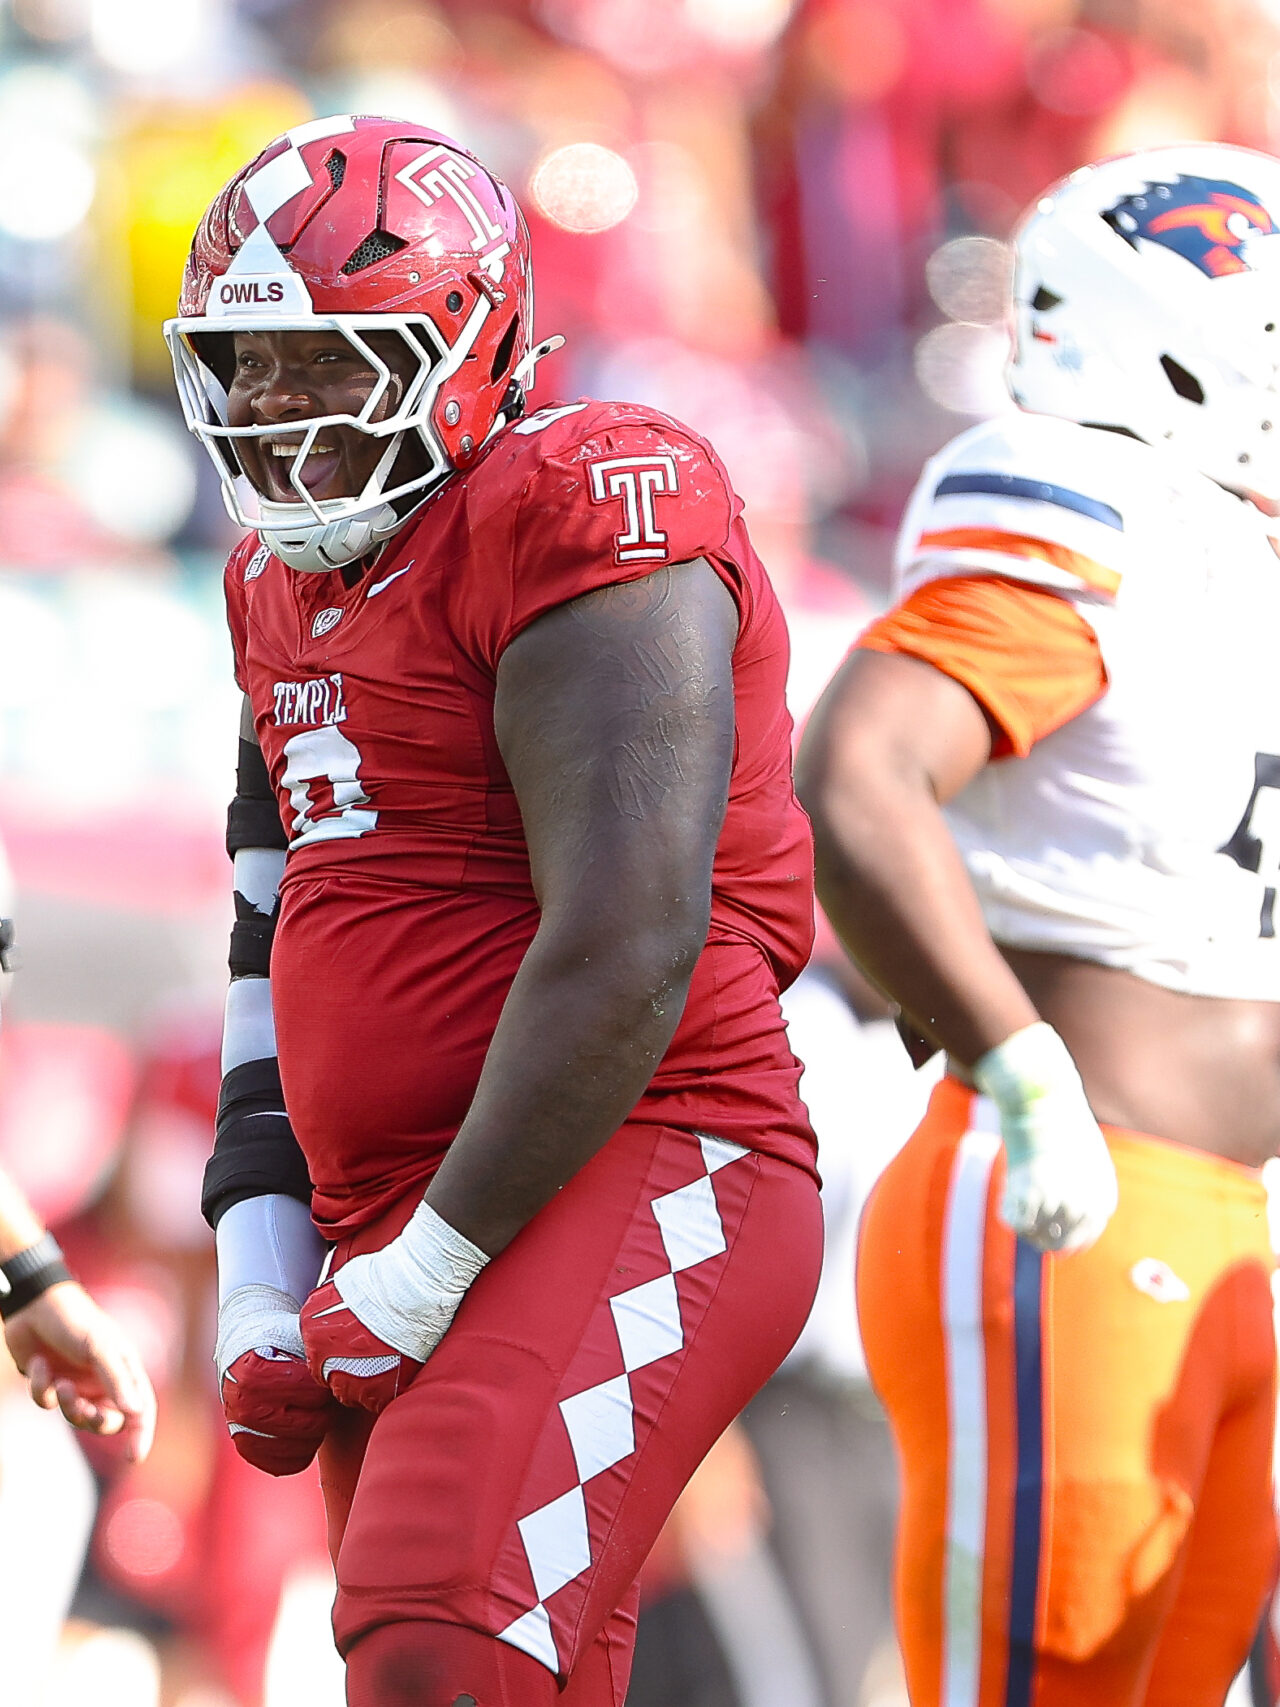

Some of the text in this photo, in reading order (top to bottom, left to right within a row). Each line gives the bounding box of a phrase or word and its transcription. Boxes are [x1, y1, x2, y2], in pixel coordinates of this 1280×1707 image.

[220, 282, 284, 304] OWLS
[589, 453, 678, 562] T
[273, 672, 347, 726] TEMPLE
